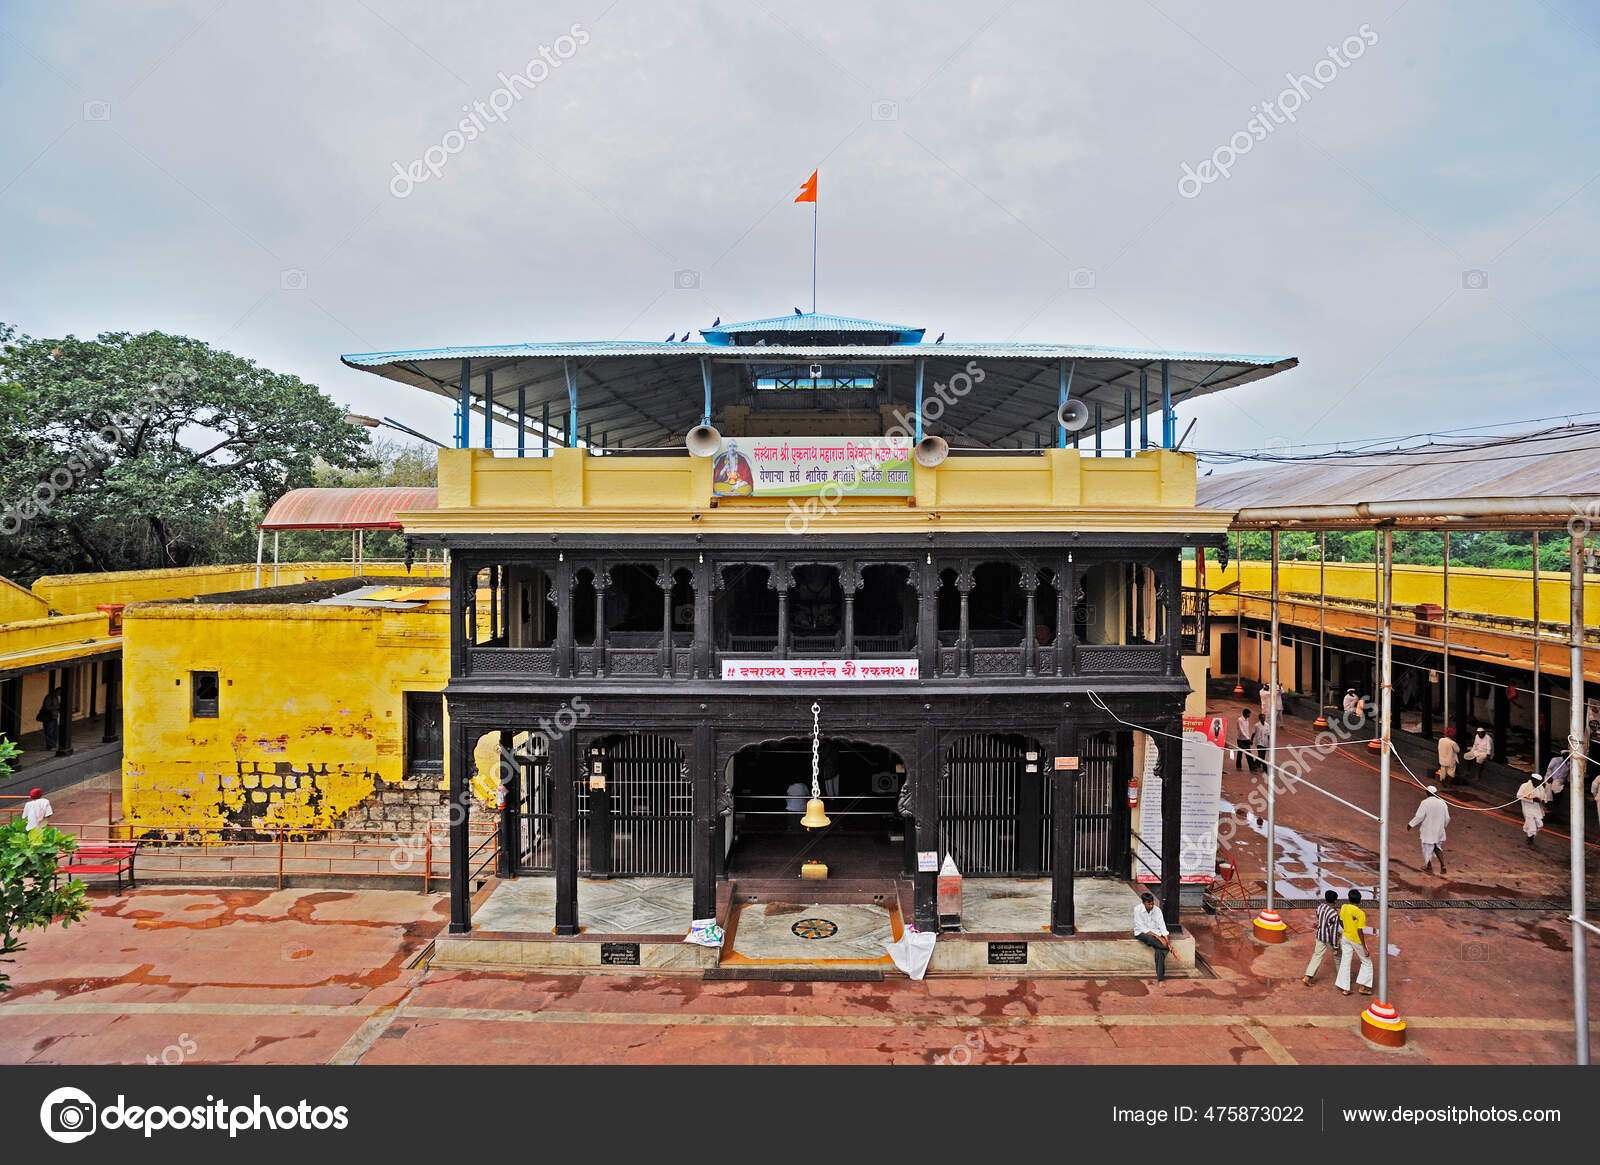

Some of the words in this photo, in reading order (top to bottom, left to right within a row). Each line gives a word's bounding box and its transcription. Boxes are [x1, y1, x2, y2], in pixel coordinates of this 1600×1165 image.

[819, 446, 845, 463] महाराज
[789, 465, 801, 482] सर्व
[805, 466, 828, 482] भाविक
[789, 661, 837, 678] जनार्दन
[841, 660, 856, 678] श्री
[860, 666, 905, 679] एकनाथ
